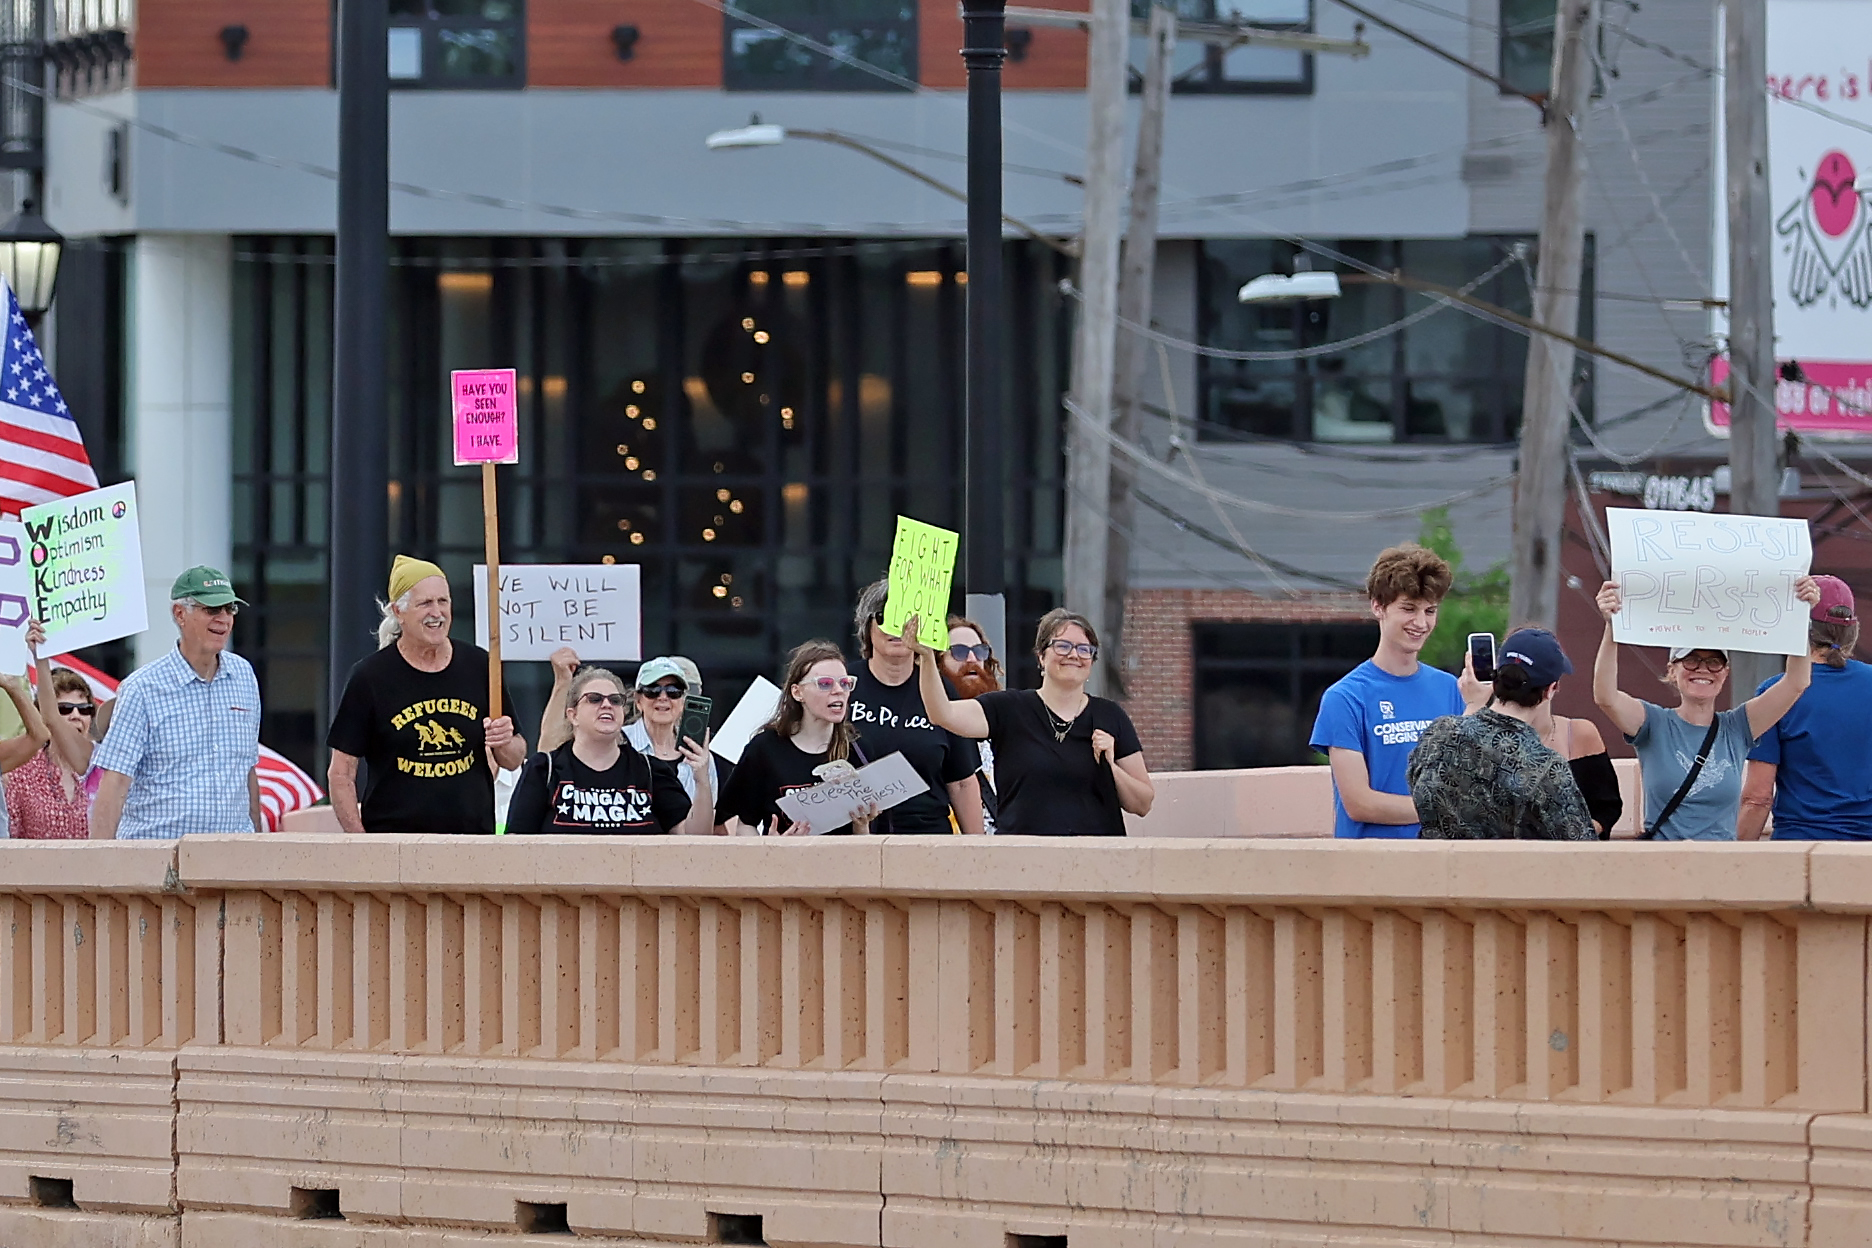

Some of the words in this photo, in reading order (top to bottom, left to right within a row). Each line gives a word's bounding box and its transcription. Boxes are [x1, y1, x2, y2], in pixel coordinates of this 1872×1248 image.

[1840, 65, 1860, 101] is
[462, 383, 486, 396] HAVE
[489, 383, 508, 395] YOU
[474, 397, 497, 410] SEEN
[466, 412, 506, 424] ENOUGH?
[471, 435, 475, 447] I
[24, 505, 105, 543] Wisdom
[1632, 517, 1805, 562] RESIST
[30, 534, 105, 568] Optimism
[899, 528, 950, 566] FIGHT
[35, 562, 105, 598] Kindness
[548, 575, 617, 593] WILL
[895, 555, 914, 584] FOR
[919, 563, 950, 592] WHAT
[36, 588, 107, 624] Empathy
[564, 598, 599, 618] BE
[901, 583, 936, 616] YOU
[1621, 564, 1806, 631] PERSIST
[509, 621, 617, 645] SILENT
[390, 697, 478, 731] REFUGEES
[851, 701, 877, 723] Be
[1382, 731, 1419, 745] BEGINS
[573, 804, 643, 822] MAGA
